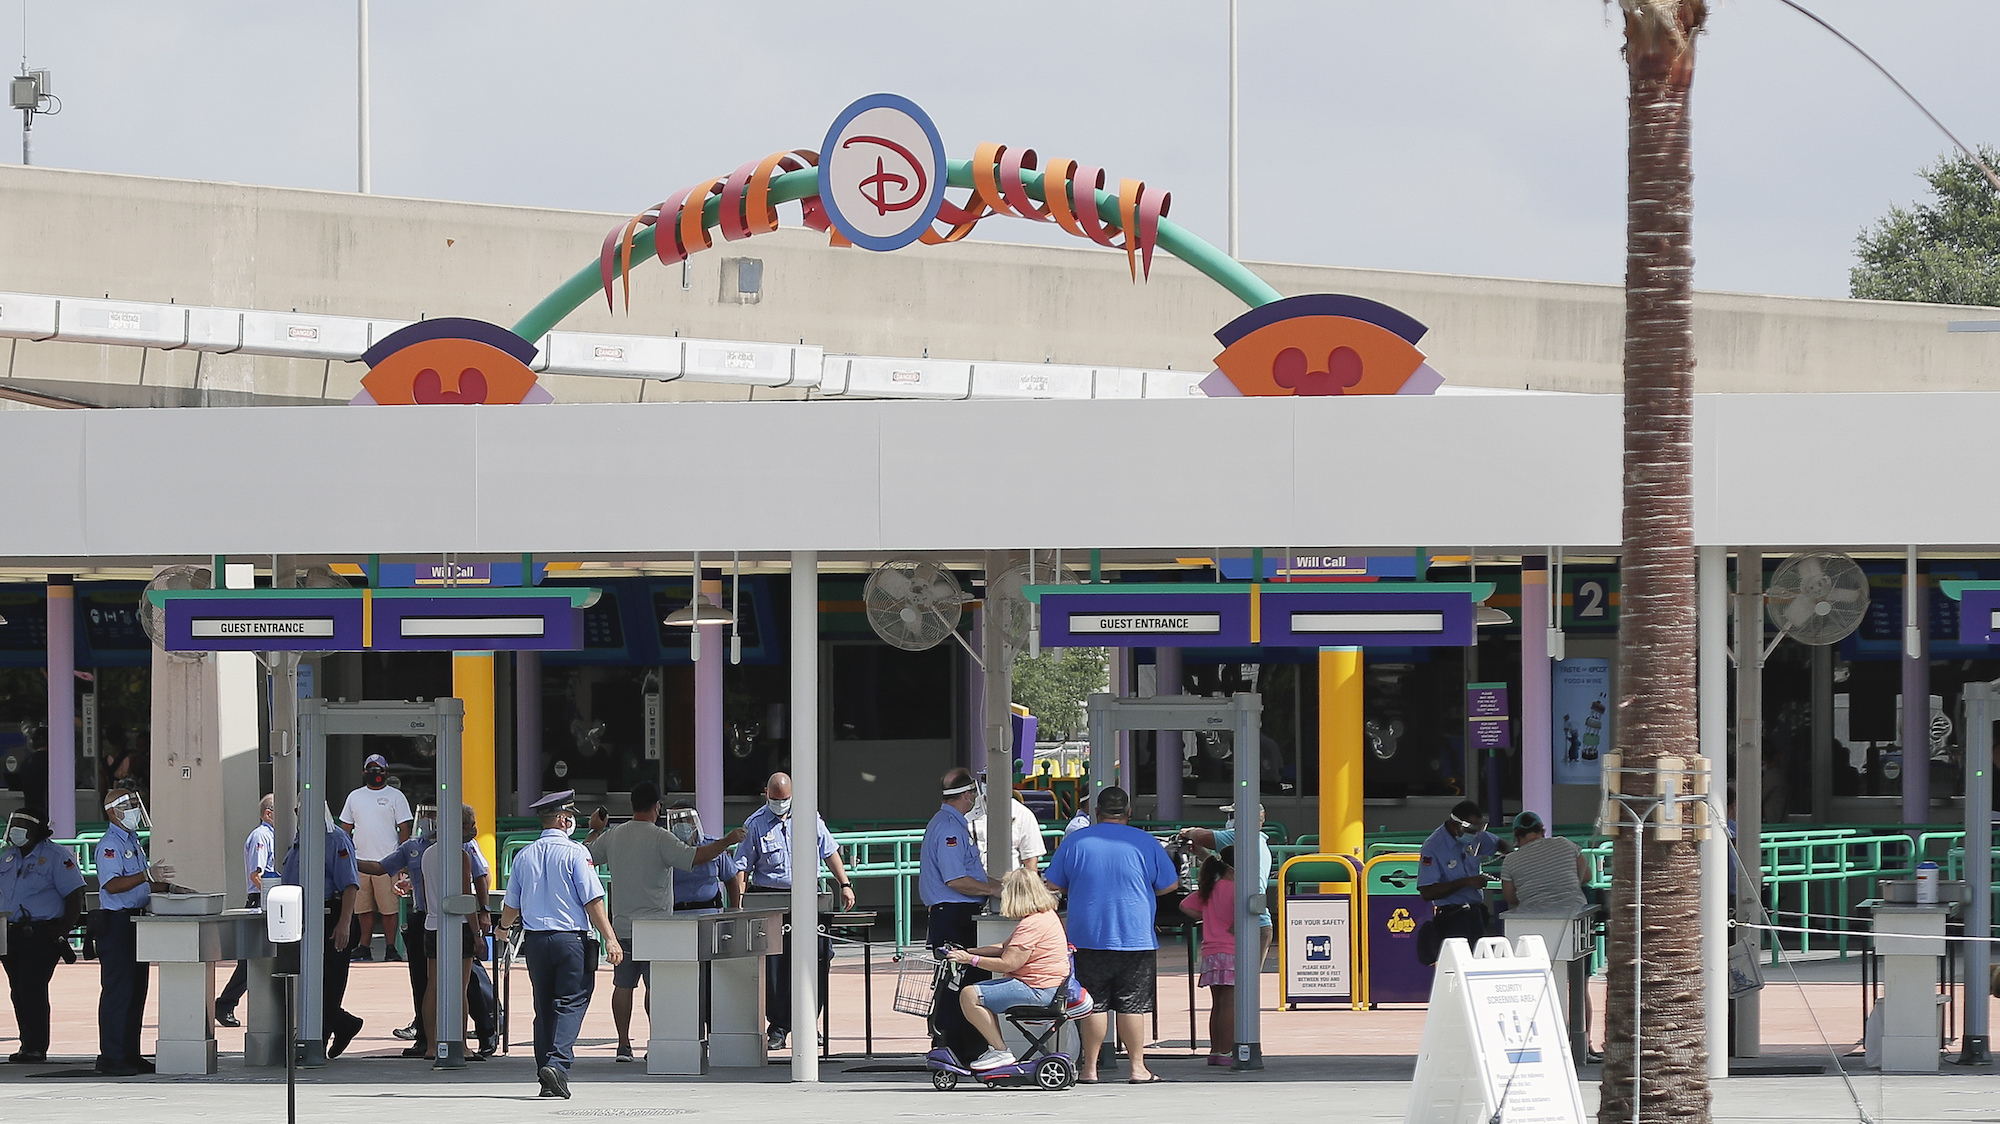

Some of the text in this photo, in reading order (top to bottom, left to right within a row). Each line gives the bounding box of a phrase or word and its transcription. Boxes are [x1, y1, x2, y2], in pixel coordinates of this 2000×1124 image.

[1296, 556, 1346, 567] Will Call
[431, 566, 451, 577] Wil
[1580, 581, 1604, 617] 2
[221, 623, 305, 633] GUEST ENTRANCE
[1100, 618, 1189, 629] GUEST ENTRANCE
[1495, 984, 1523, 992] SECURITY
[1487, 994, 1537, 1004] SCREENING AREA
